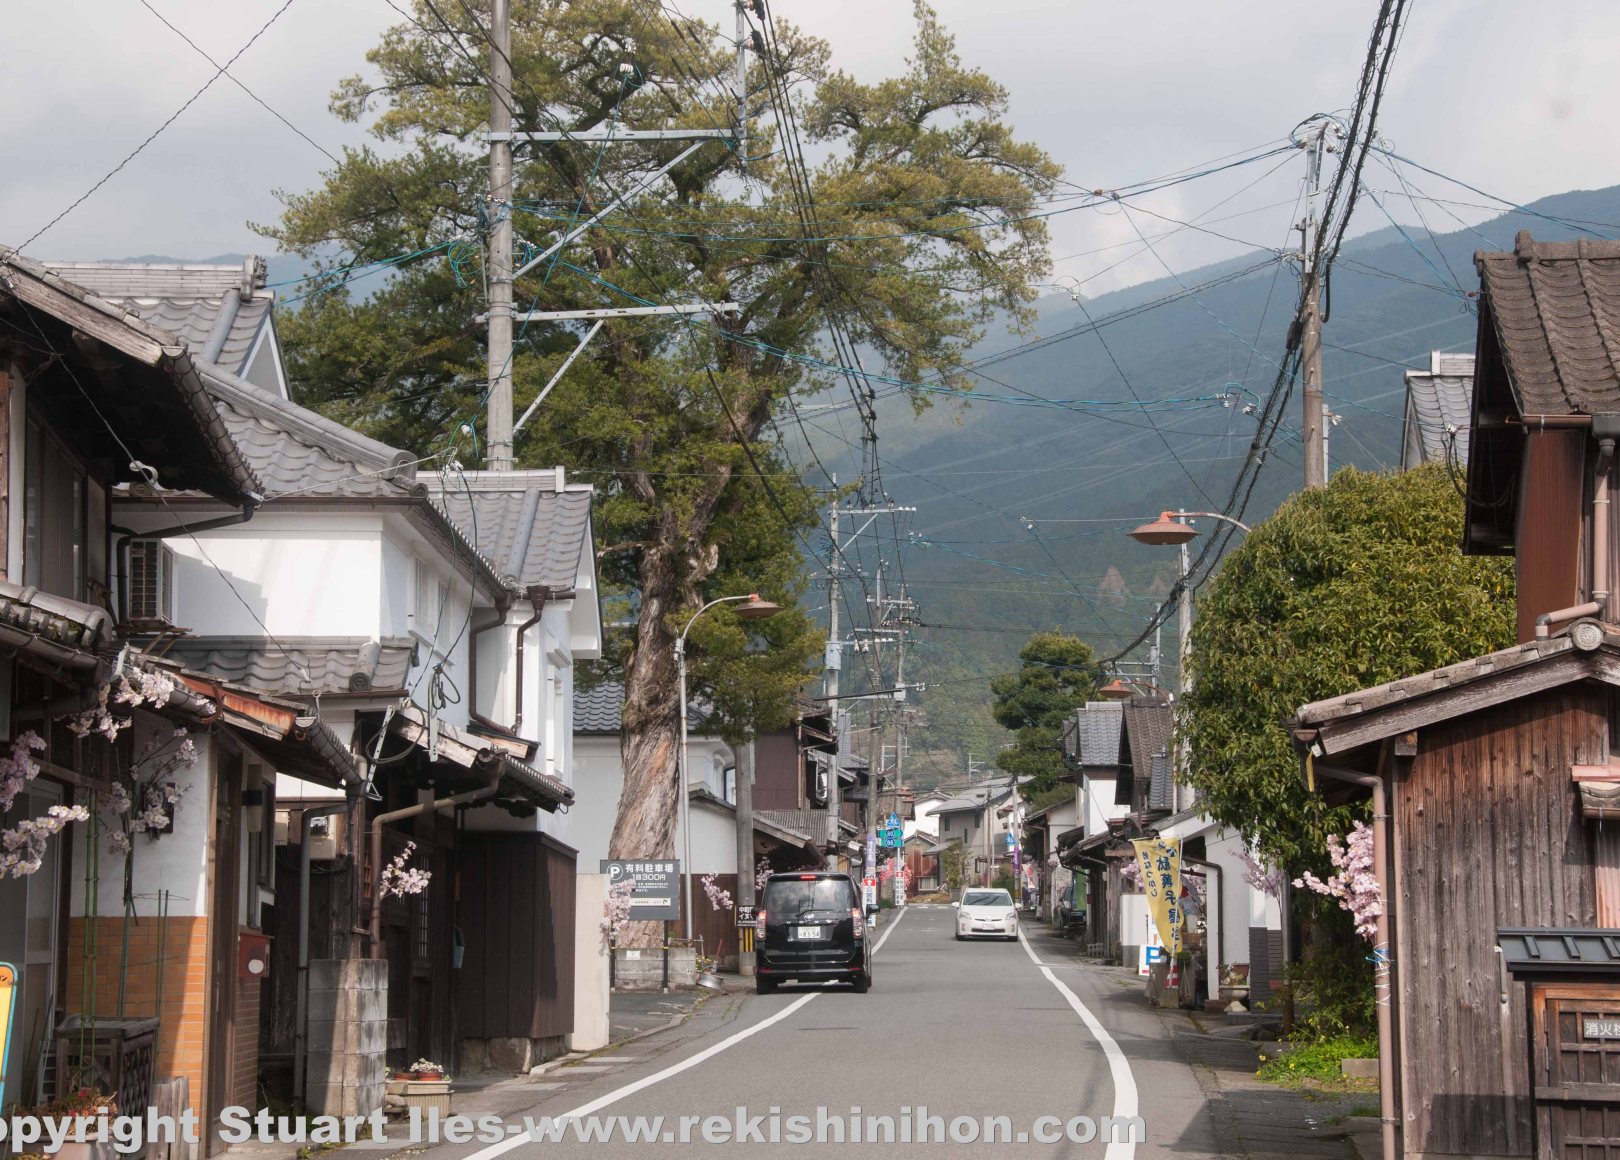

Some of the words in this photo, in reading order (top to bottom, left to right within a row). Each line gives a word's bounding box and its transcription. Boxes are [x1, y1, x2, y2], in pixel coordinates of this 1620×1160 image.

[610, 866, 620, 878] P
[625, 863, 674, 873] 有料駐車場
[1146, 946, 1161, 965] P
